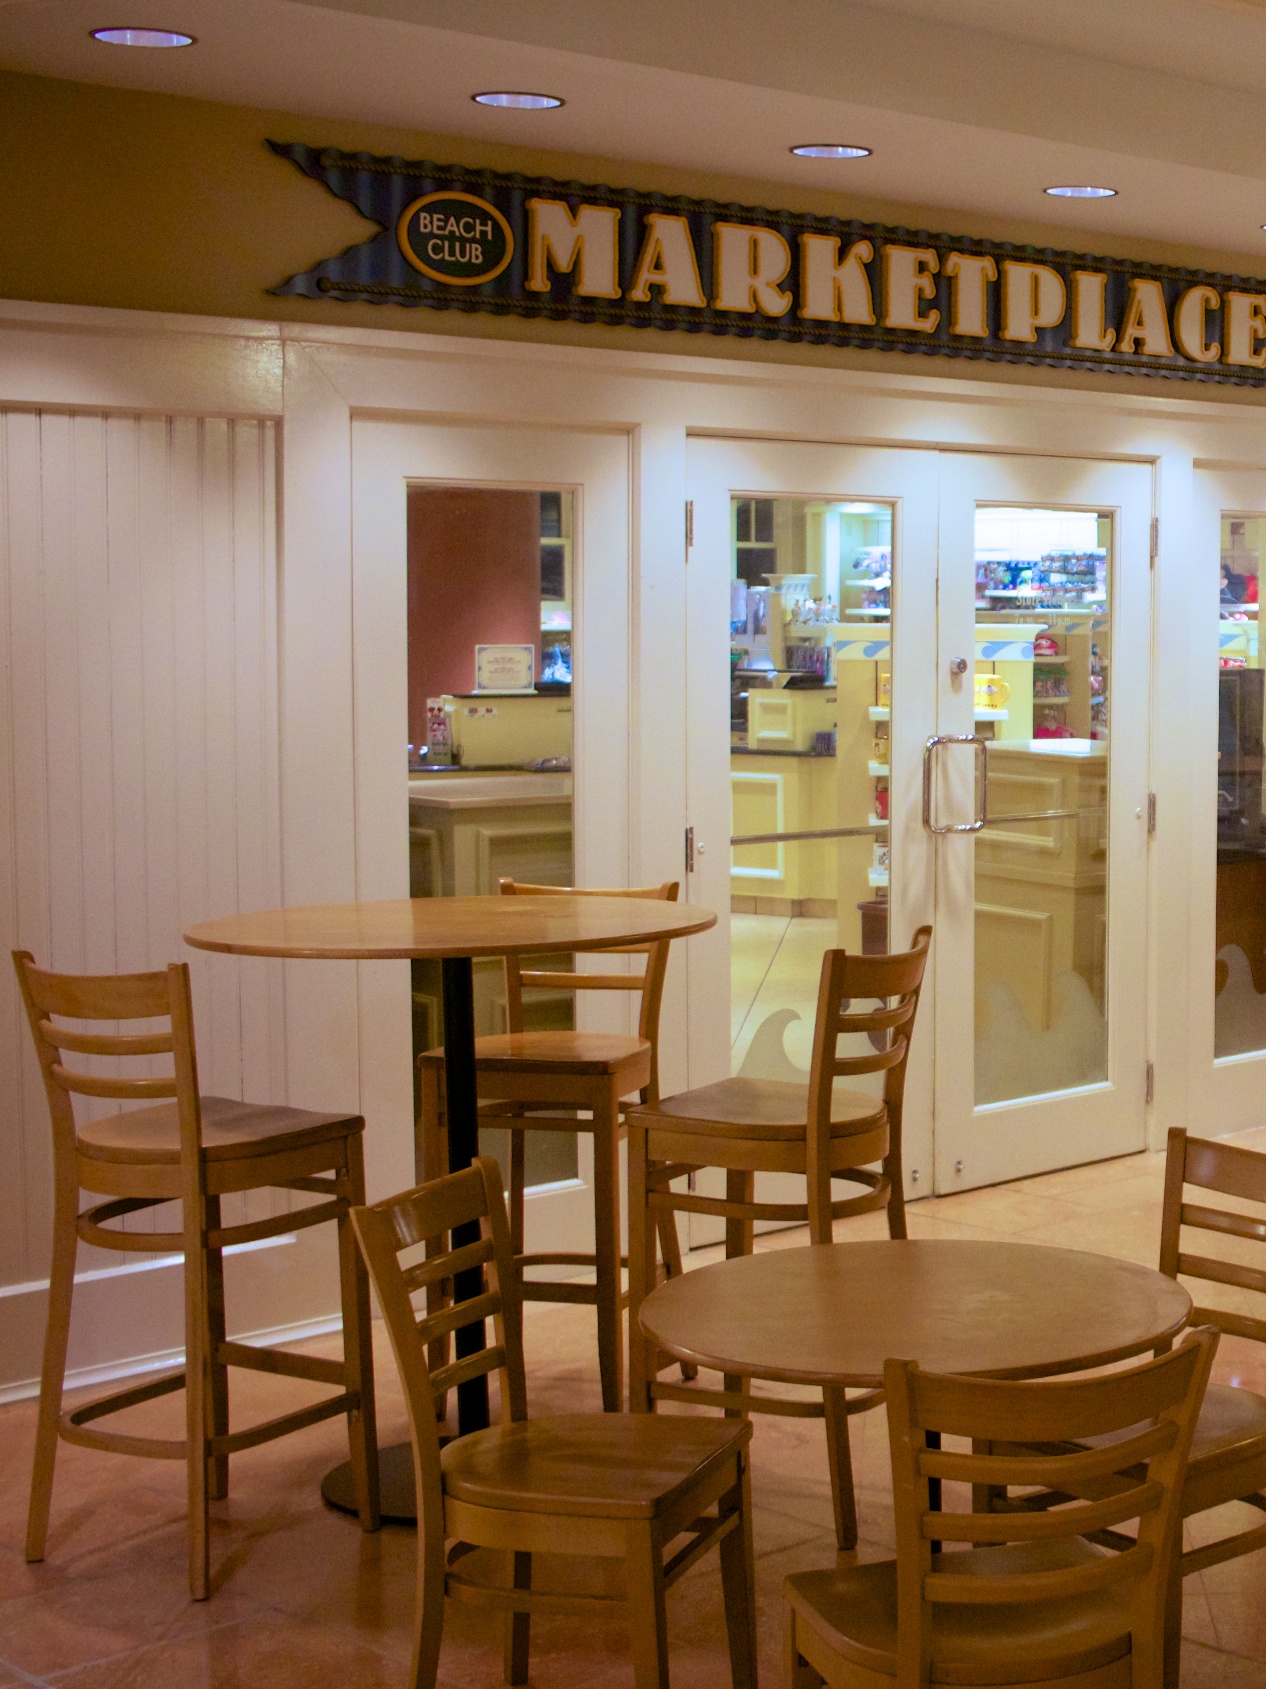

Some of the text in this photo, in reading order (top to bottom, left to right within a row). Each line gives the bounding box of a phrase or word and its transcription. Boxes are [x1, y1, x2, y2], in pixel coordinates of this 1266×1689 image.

[419, 211, 493, 240] BEACH
[427, 238, 483, 264] CLUB
[1016, 595, 1041, 606] Store
